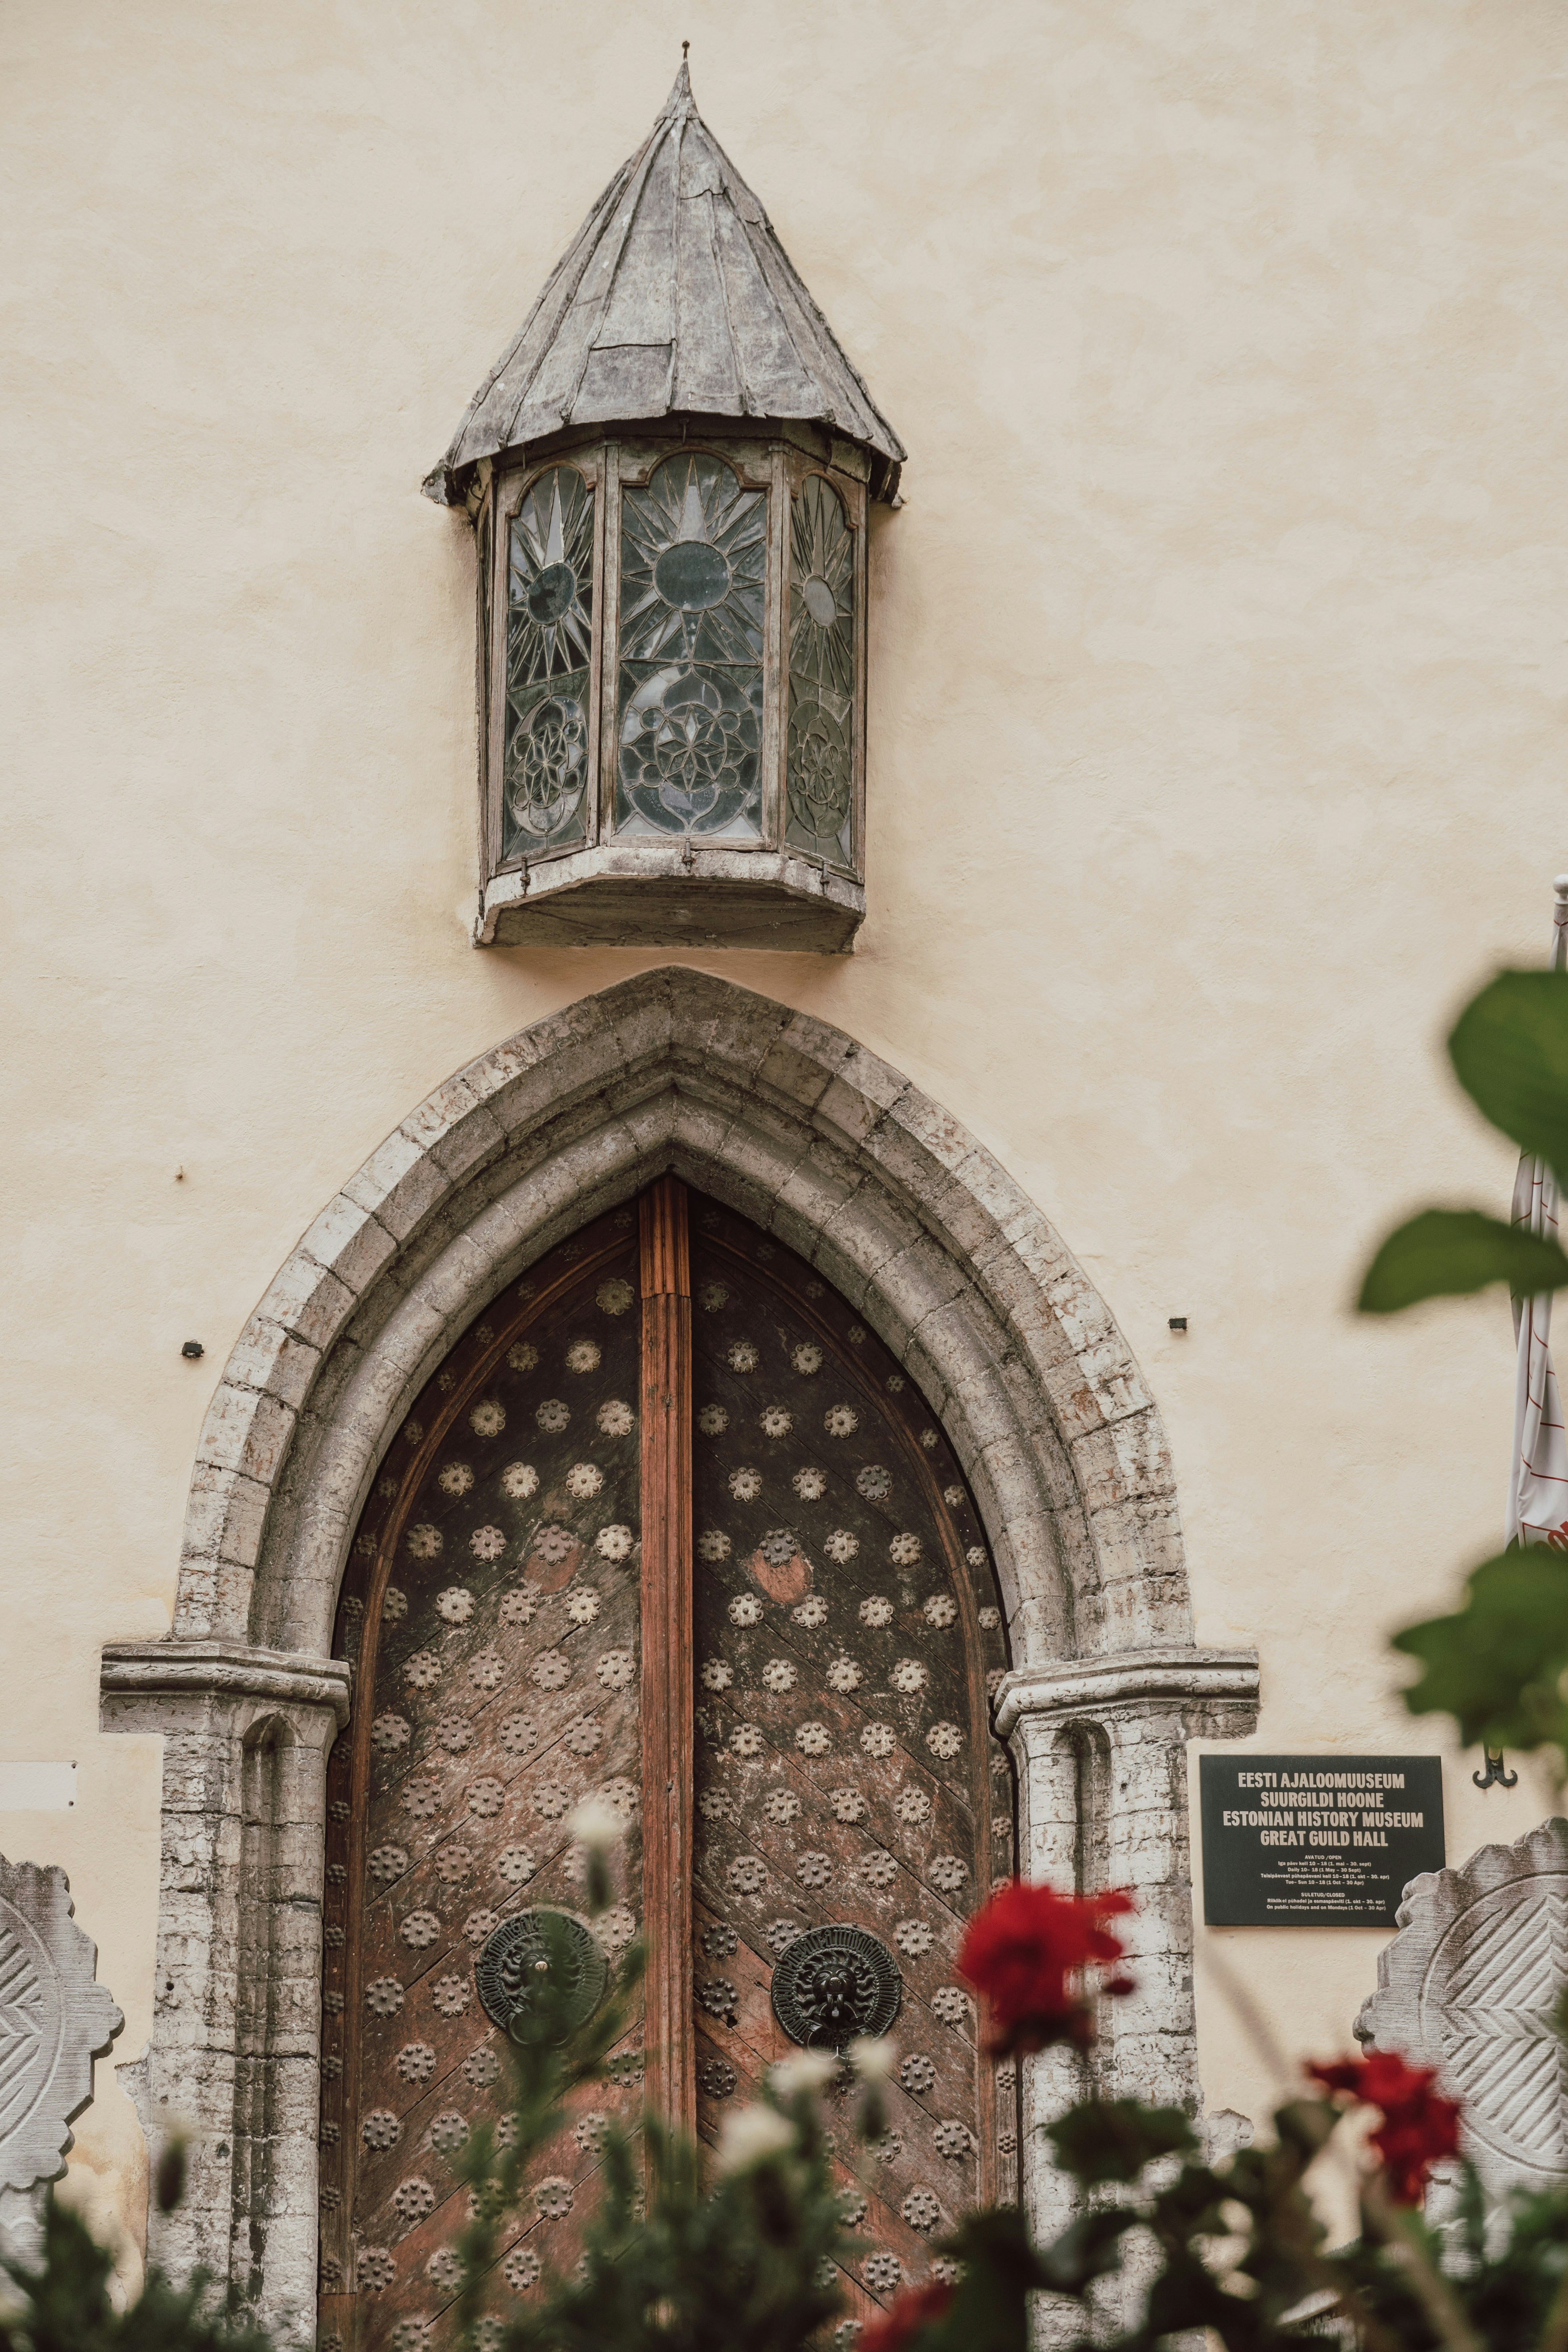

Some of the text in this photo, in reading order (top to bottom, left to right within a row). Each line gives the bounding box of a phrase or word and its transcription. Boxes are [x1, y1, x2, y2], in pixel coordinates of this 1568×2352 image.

[1238, 1772, 1405, 1789] EESTI AJALOOMUUSEUM
[1261, 1792, 1384, 1807] SUURGILDI HOONE
[1223, 1811, 1423, 1827] ESTONIAN HISTORY MUSEUM
[1261, 1830, 1388, 1846] GREAT GUILD HALL
